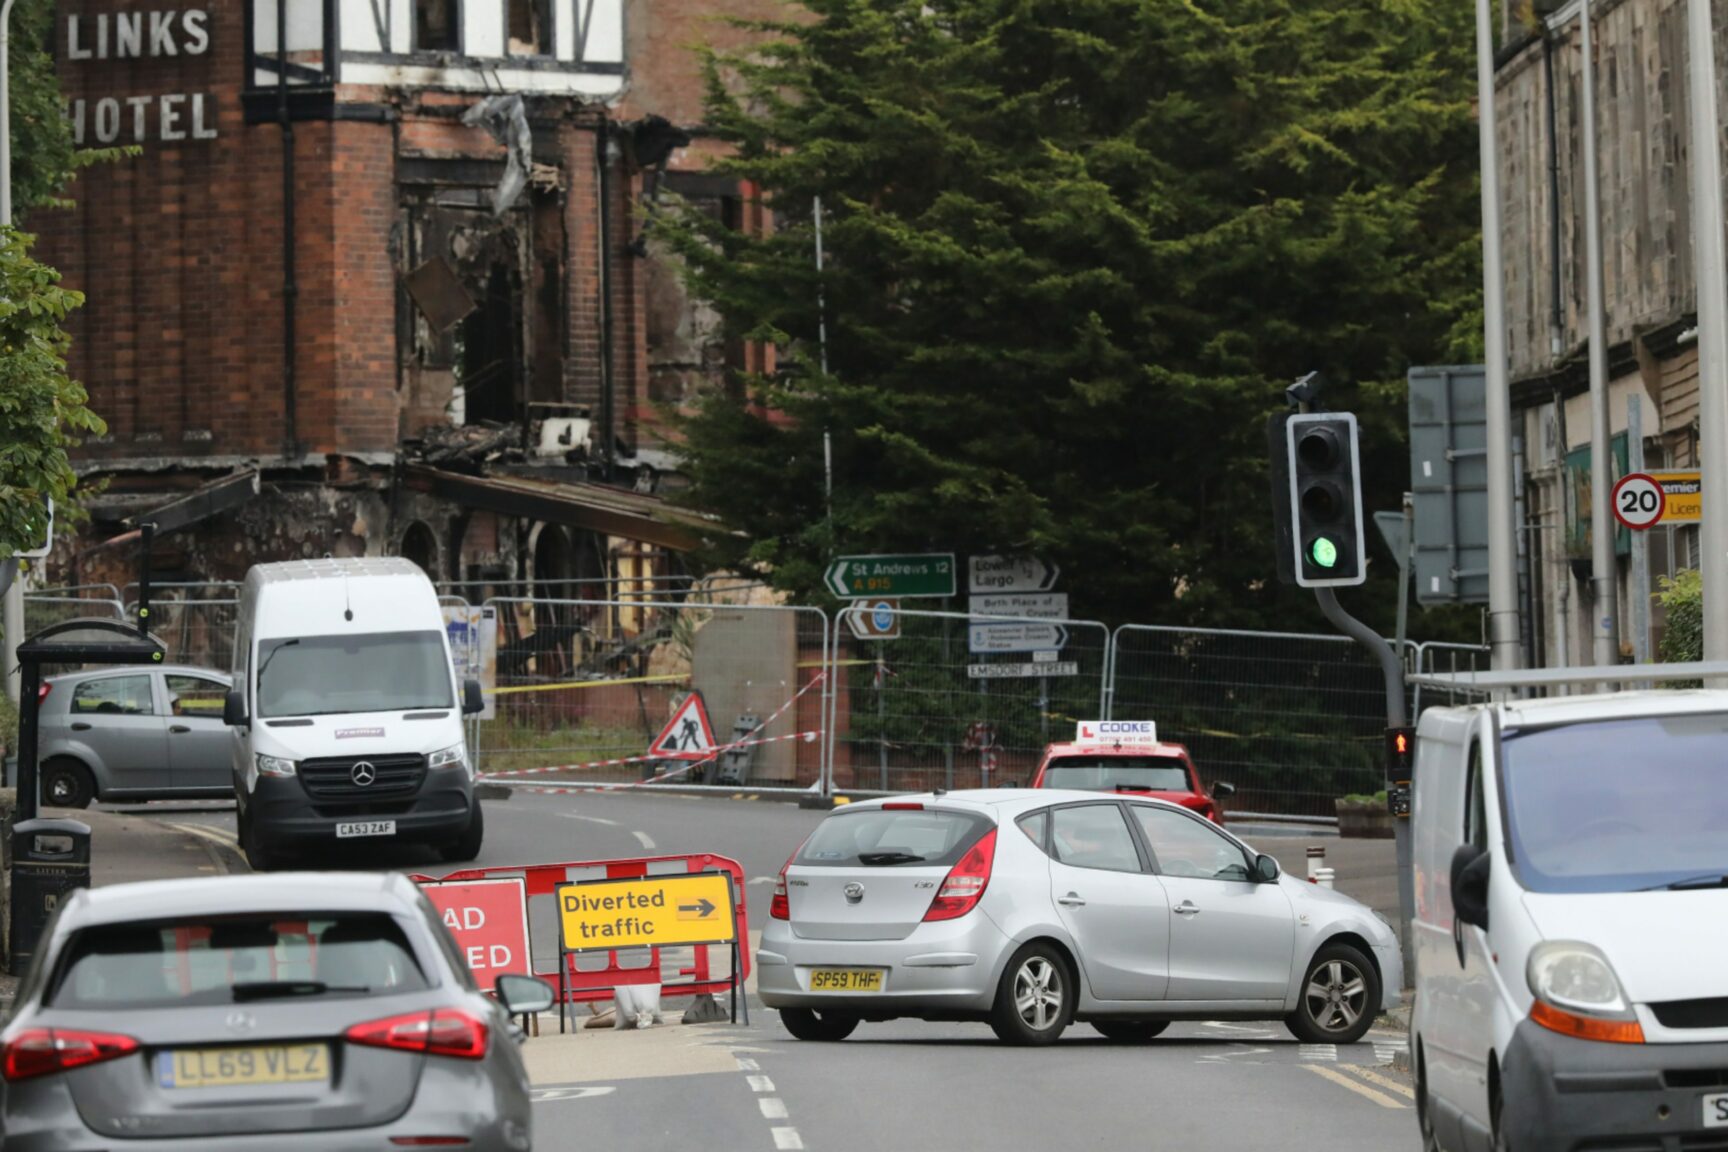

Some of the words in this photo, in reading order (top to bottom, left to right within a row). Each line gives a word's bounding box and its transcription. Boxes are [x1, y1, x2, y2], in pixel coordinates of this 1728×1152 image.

[68, 9, 208, 59] LINKS
[1661, 484, 1698, 494] emier
[1621, 490, 1657, 512] 20
[852, 563, 867, 576] St
[874, 562, 928, 575] Andrews
[936, 562, 949, 573] 12
[976, 559, 1014, 571] Lower
[853, 578, 864, 589] A
[868, 577, 891, 589] 915
[976, 574, 1014, 587] Largo
[1012, 598, 1037, 606] Place
[1032, 662, 1074, 675] STREET
[1082, 726, 1094, 738] L
[1100, 723, 1150, 733] COOKE
[340, 824, 368, 836] CA53
[371, 822, 391, 833] ZAF
[564, 889, 665, 913] Diverted
[580, 917, 655, 938] traffic
[816, 971, 848, 987] SP59
[852, 972, 876, 987] THF
[180, 1052, 255, 1079] LL69
[265, 1048, 321, 1075] VLZ
